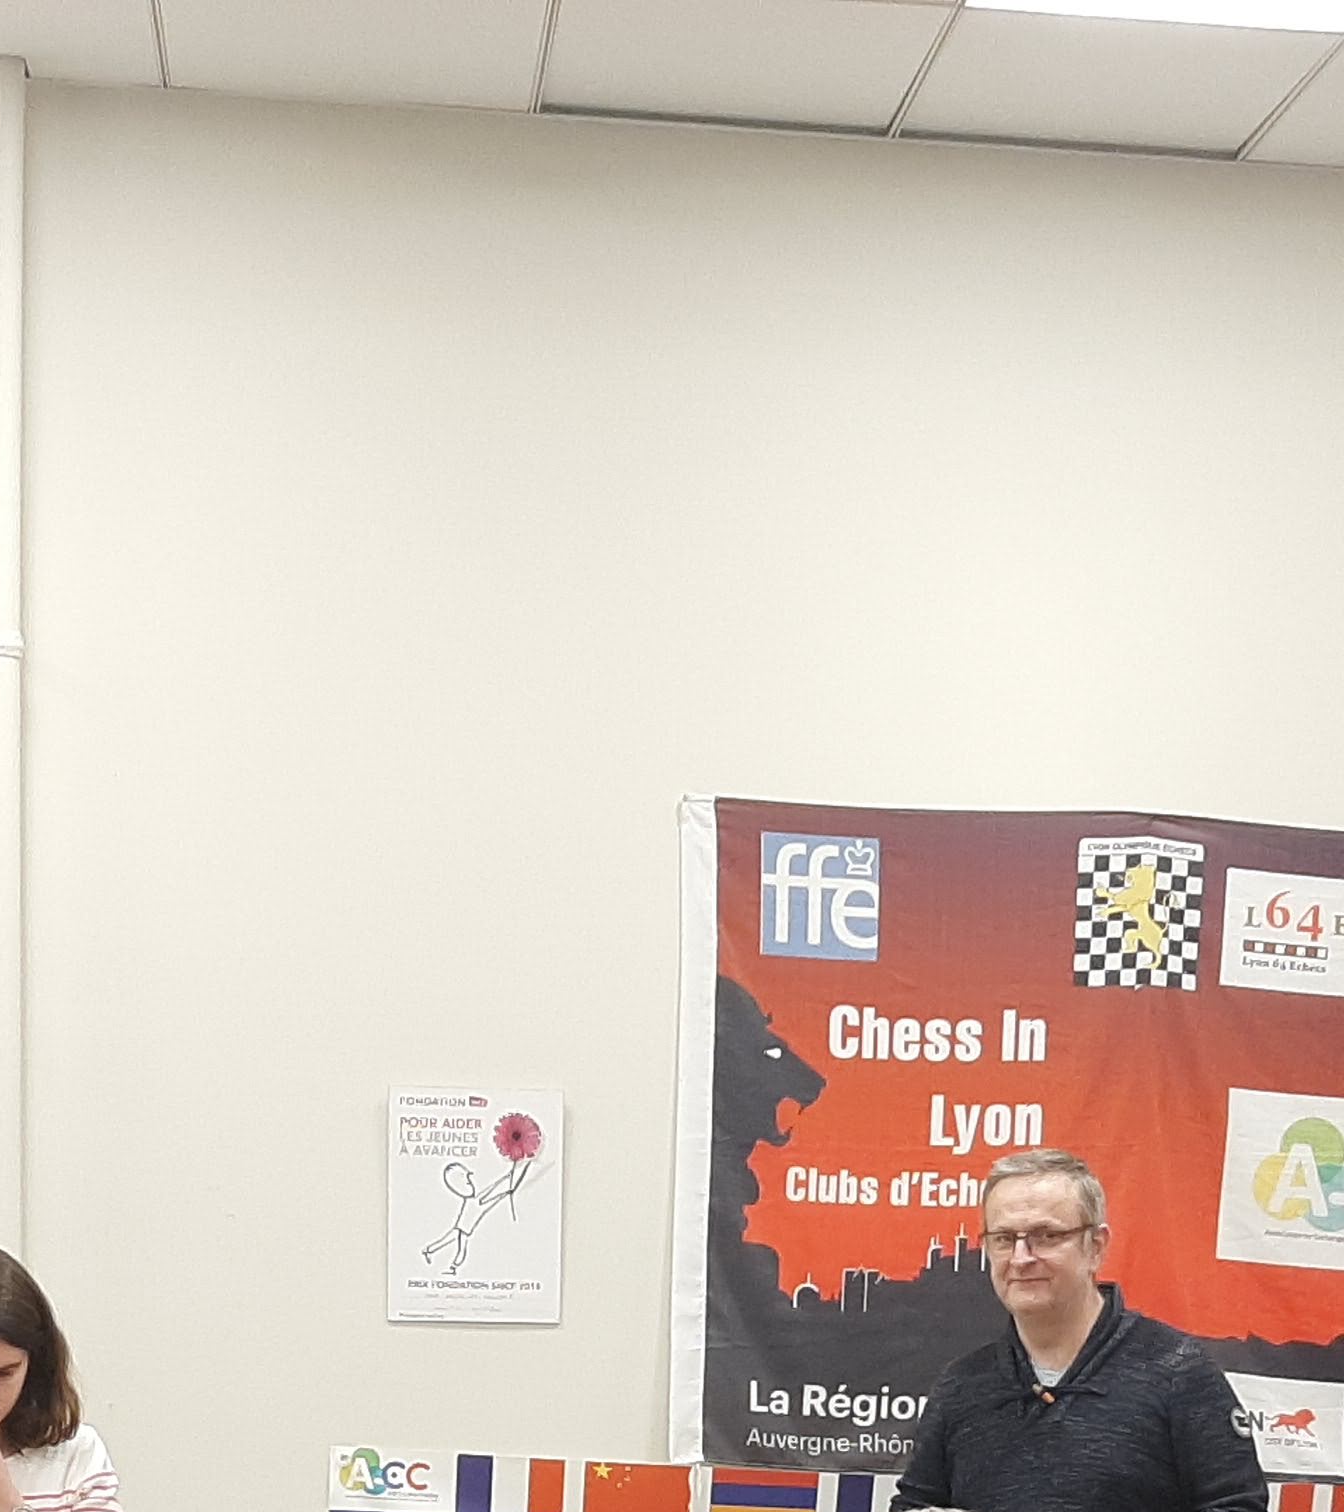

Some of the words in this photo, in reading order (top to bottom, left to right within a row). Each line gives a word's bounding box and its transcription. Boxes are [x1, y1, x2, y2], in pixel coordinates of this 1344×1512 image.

[828, 1004, 983, 1063] Chess
[1001, 1008, 1047, 1062] In
[928, 1093, 1044, 1156] Lyon
[785, 1165, 879, 1205] Clubs
[749, 1380, 790, 1415] La
